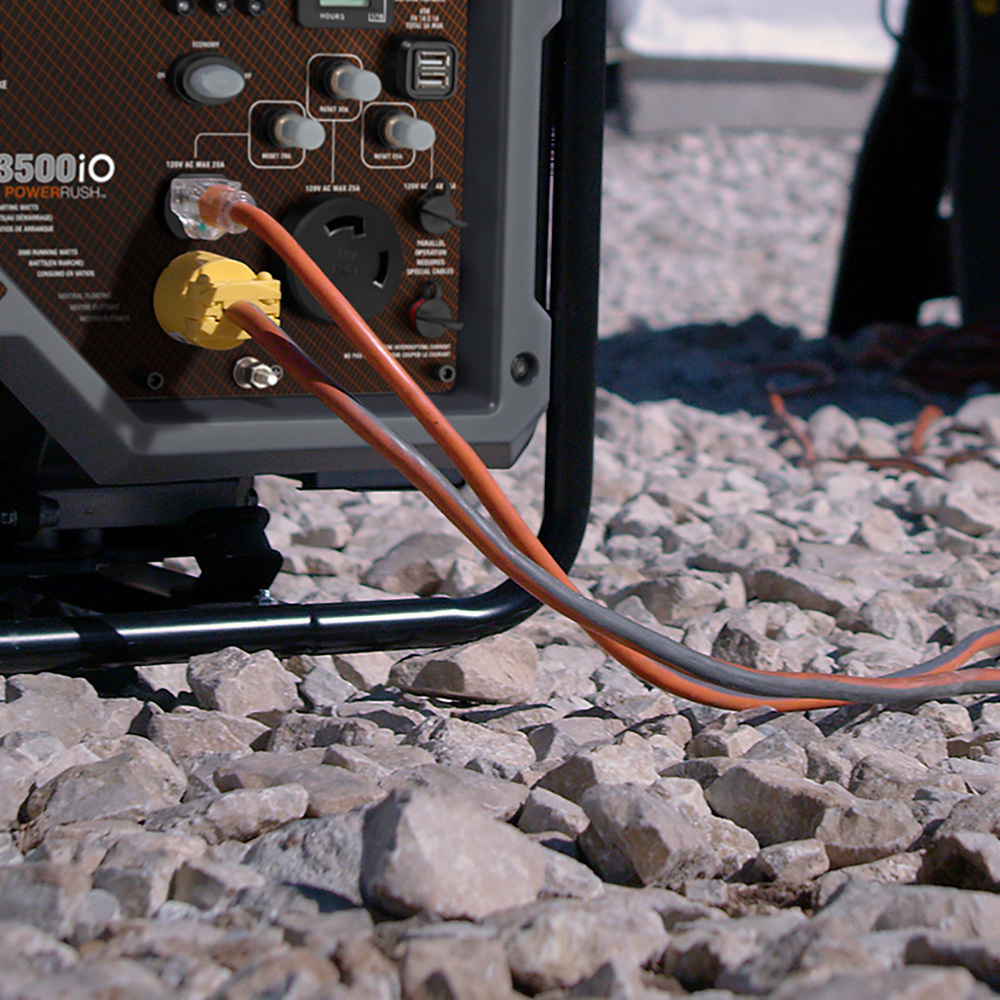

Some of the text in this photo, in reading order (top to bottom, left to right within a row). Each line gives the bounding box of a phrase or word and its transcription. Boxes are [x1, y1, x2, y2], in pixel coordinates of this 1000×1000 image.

[319, 12, 345, 21] HOURS
[373, 152, 391, 160] RESET
[305, 184, 360, 192] 120V AC MAX 25A
[404, 182, 419, 190] 120V
[416, 239, 446, 247] PARALLEL
[59, 248, 78, 256] WATTS
[416, 258, 445, 266] REQUIRES
[406, 267, 454, 275] SPECIAL CABLES
